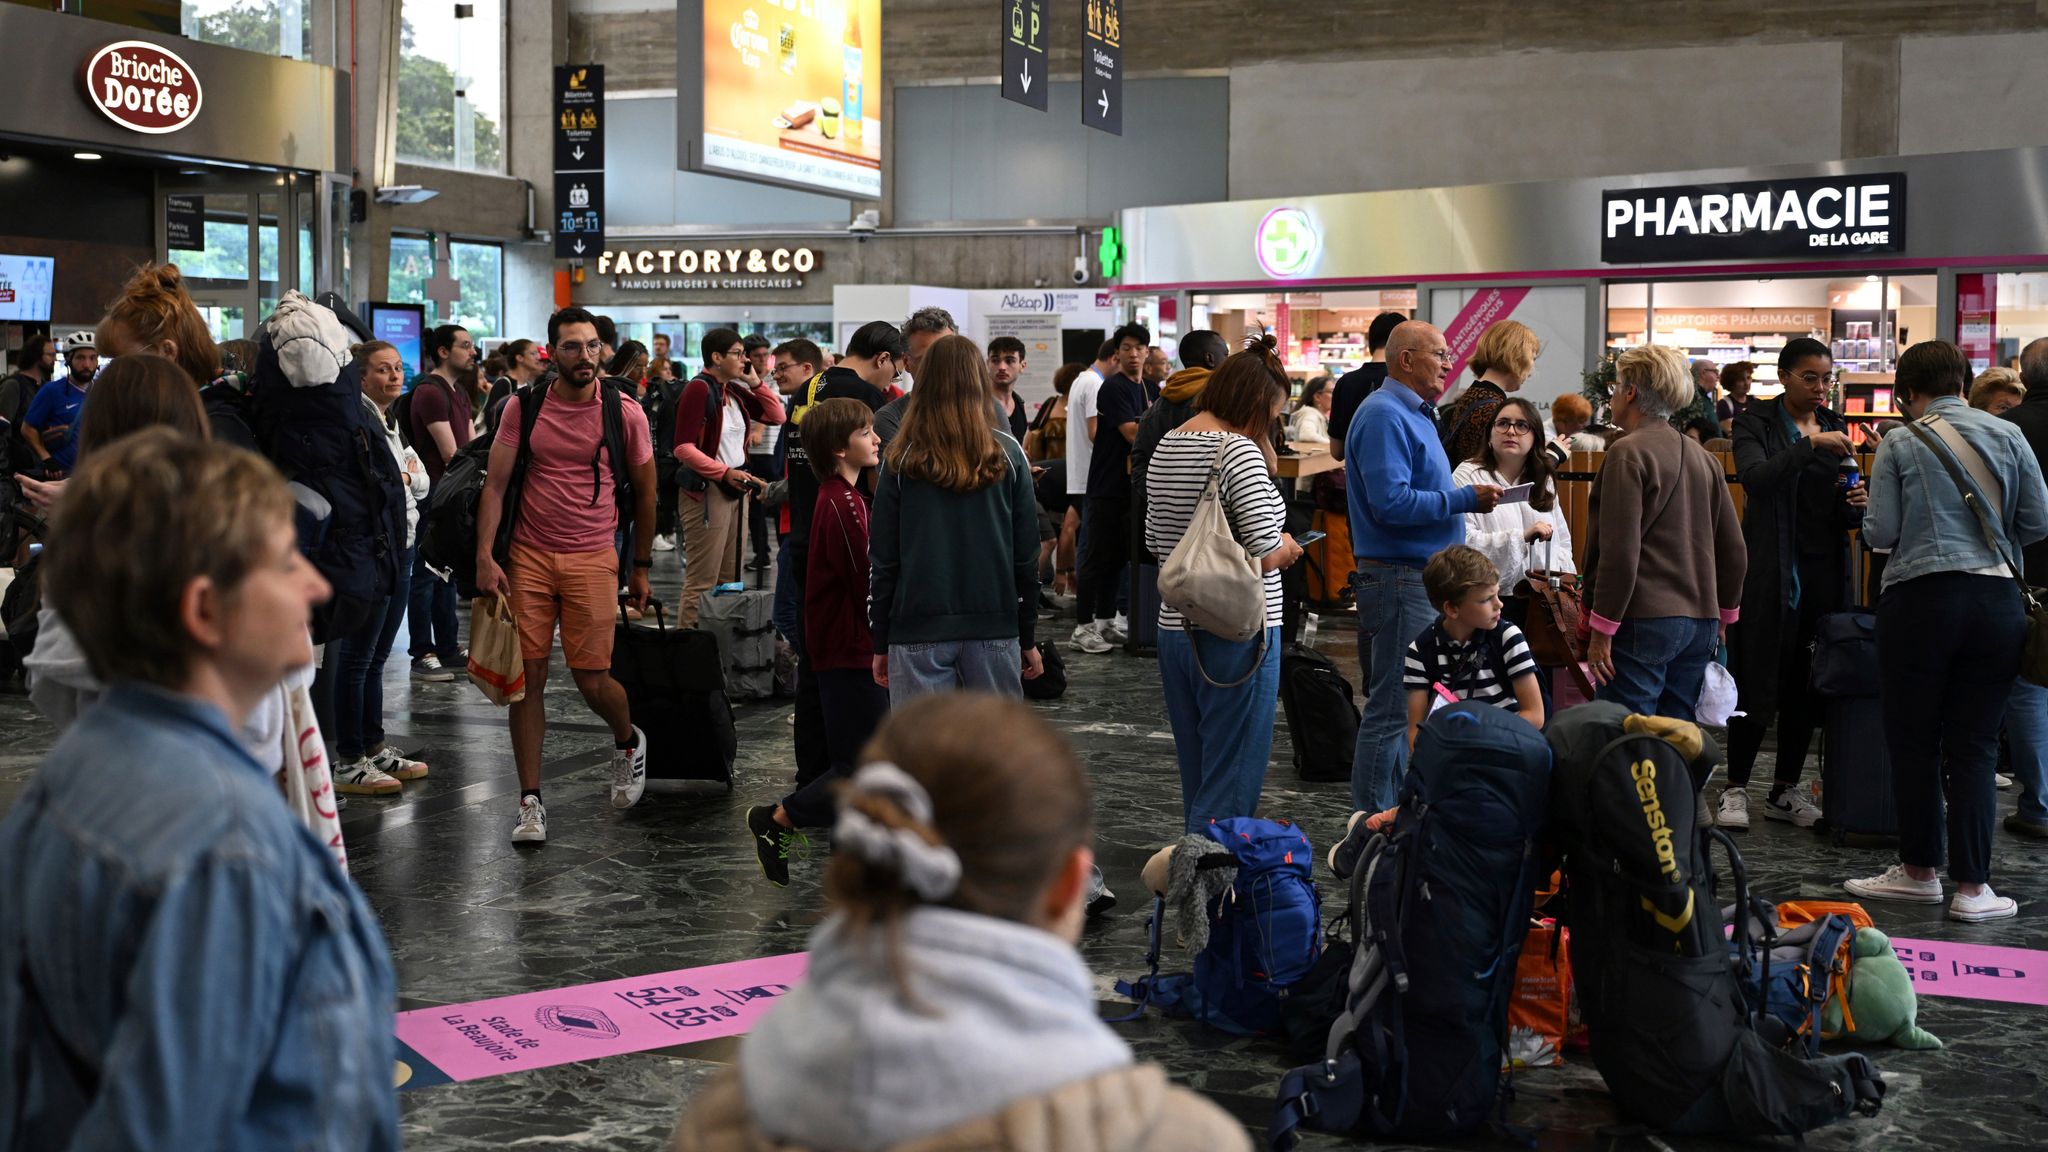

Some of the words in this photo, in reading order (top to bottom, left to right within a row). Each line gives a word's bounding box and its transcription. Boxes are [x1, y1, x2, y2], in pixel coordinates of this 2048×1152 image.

[110, 51, 183, 87] Brioche
[104, 77, 190, 118] Dorée
[561, 218, 575, 231] 10
[584, 217, 599, 231] 11
[1606, 184, 1890, 238] PHARMACIE
[1809, 234, 1829, 247] DE
[1830, 233, 1849, 246] LA
[1850, 231, 1889, 245] GARE
[598, 248, 814, 274] FACTORY&CO
[622, 280, 662, 290] FAMOUS
[665, 279, 708, 289] BURGERS
[712, 279, 718, 288] &
[722, 278, 793, 289] CHEESECAKES
[1452, 288, 1500, 348] ANTIGÉNIQUES
[1457, 298, 1505, 355] RENDEZ-VOUS
[1731, 314, 1816, 326] PHARMACIE
[626, 986, 684, 1006] 54
[661, 1006, 723, 1027] 55
[442, 1014, 465, 1026] La
[456, 1024, 518, 1062] Beaujoire
[481, 1016, 523, 1039] Stade
[514, 1038, 539, 1049] de
